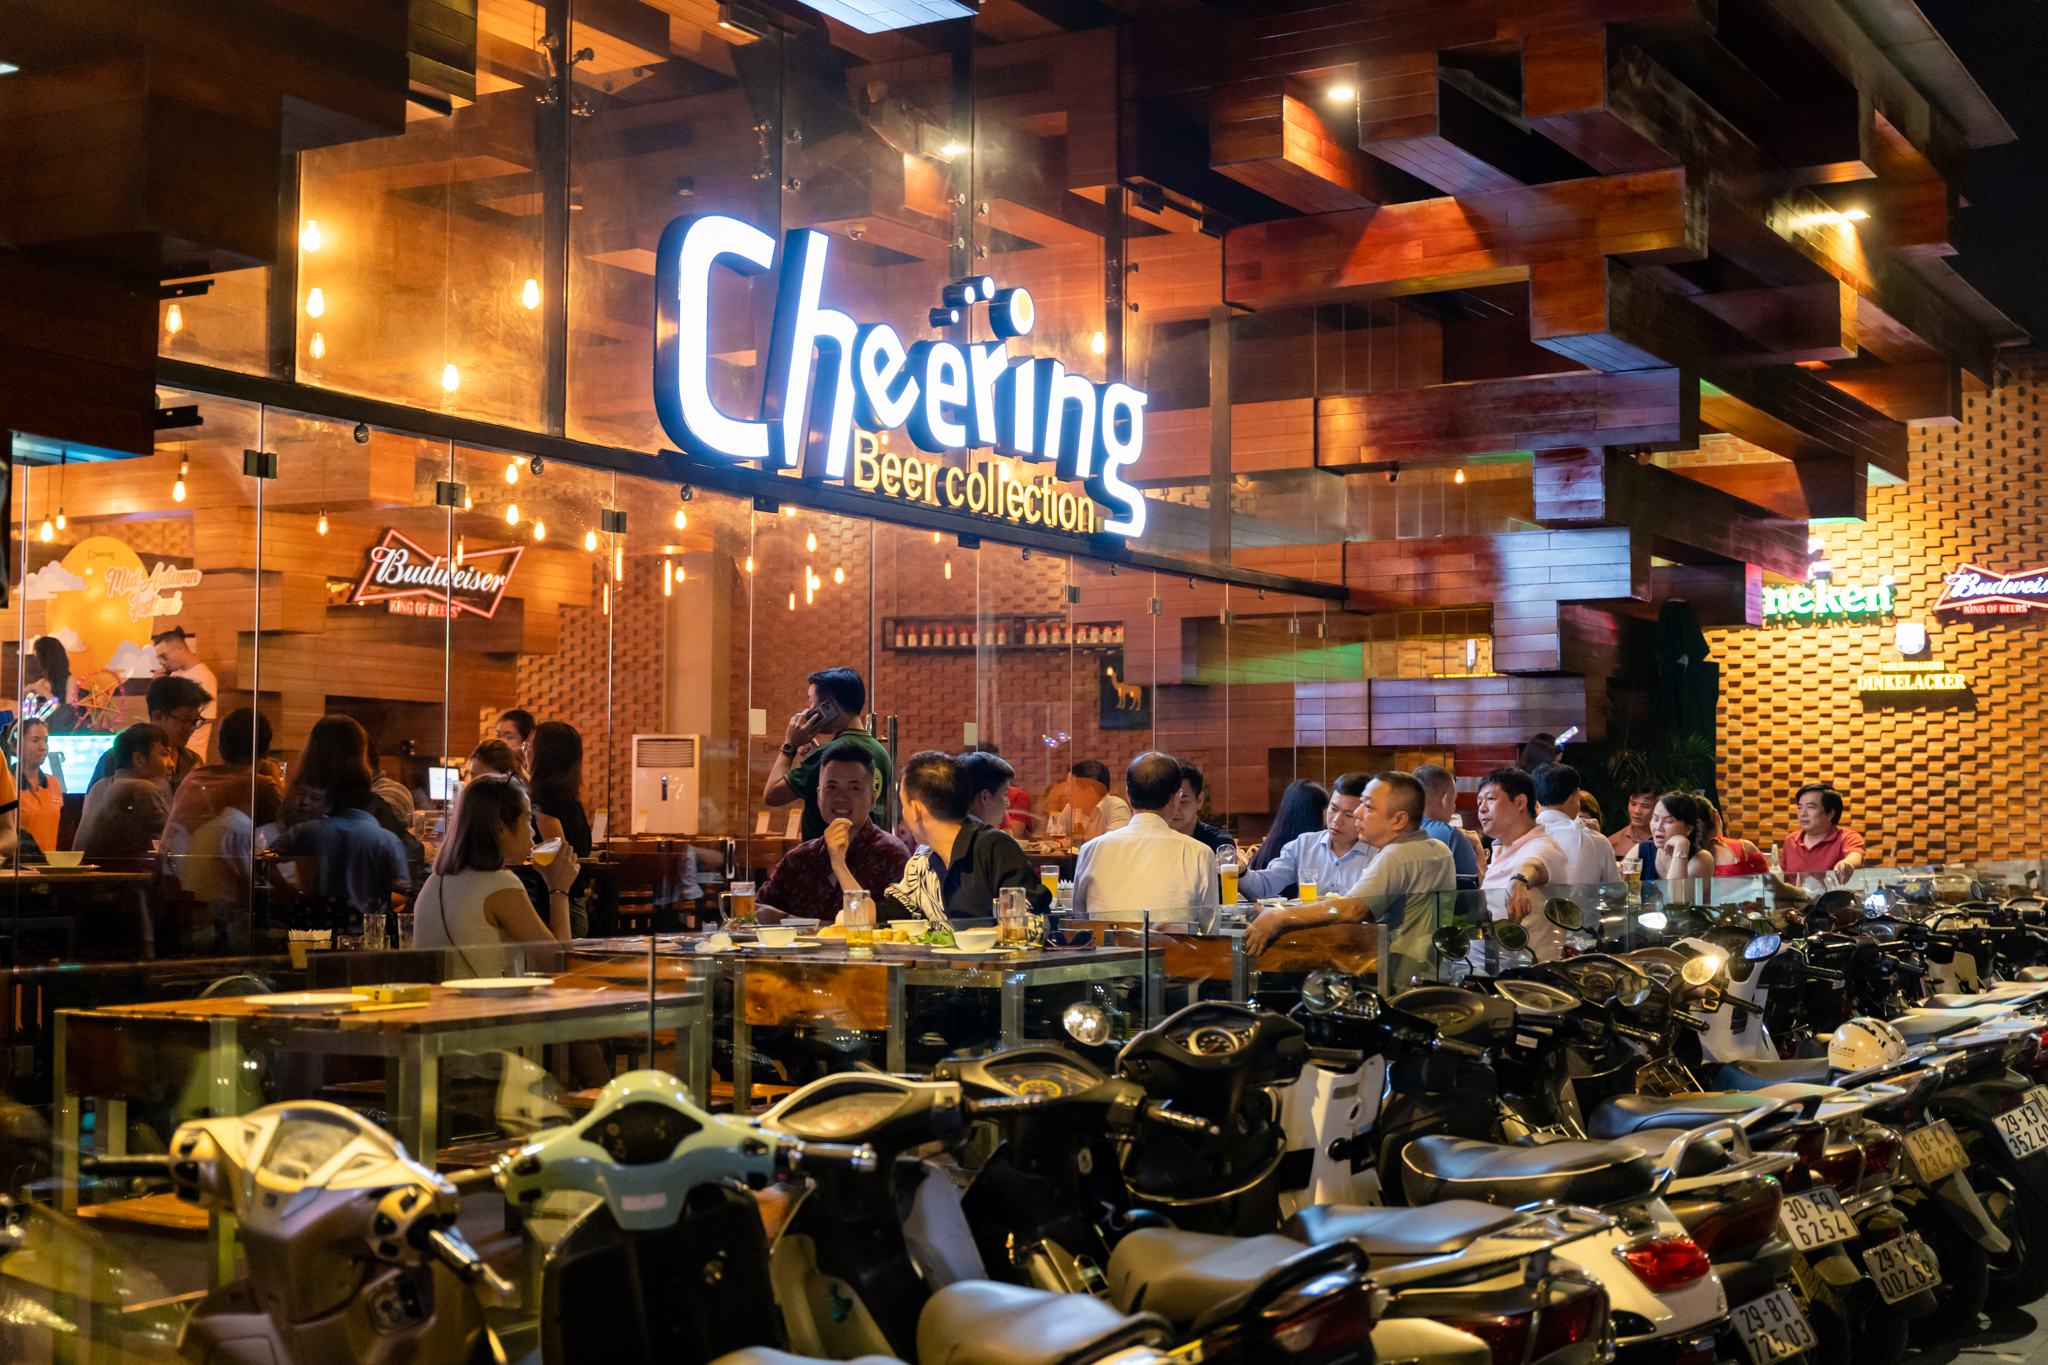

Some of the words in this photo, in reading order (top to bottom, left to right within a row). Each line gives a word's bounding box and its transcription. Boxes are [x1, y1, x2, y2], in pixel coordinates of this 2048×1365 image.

[677, 214, 1149, 539] Cheering
[853, 429, 937, 501] Beer
[945, 460, 1094, 534] collection
[371, 546, 506, 593] Budweiser
[388, 600, 414, 613] KING
[415, 602, 427, 616] OF
[1963, 604, 1986, 615] KING
[1986, 604, 1998, 615] OF
[1856, 673, 1966, 691] DINKELACKER
[1783, 1191, 1835, 1222] 30-F9
[1795, 1215, 1849, 1246] 6254
[1880, 1260, 1936, 1297] 002.69
[1739, 1293, 1791, 1334] 29-B1
[1748, 1319, 1812, 1364] 725.03
